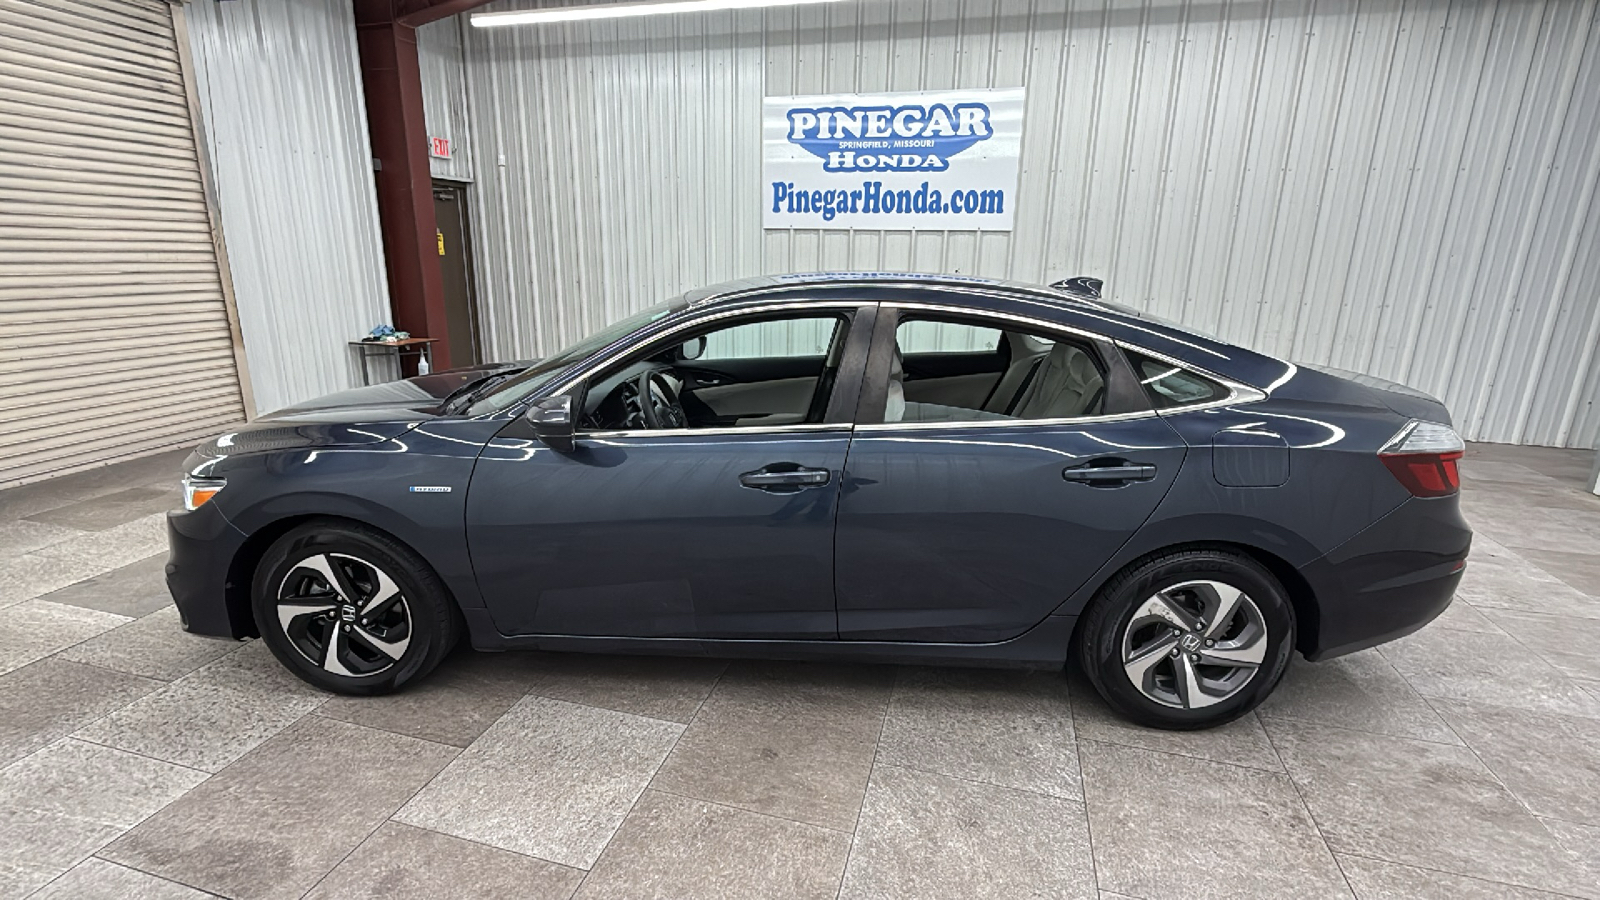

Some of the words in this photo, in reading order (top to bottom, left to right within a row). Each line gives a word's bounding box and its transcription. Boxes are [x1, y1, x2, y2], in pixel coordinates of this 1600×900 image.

[790, 107, 990, 139] PINEGAR
[433, 137, 449, 157] EXIT
[838, 140, 892, 149] SPRINGFIELD,
[893, 140, 935, 148] MISSOURI
[826, 151, 945, 169] HONDA
[771, 181, 1004, 221] PinegarHonda.com
